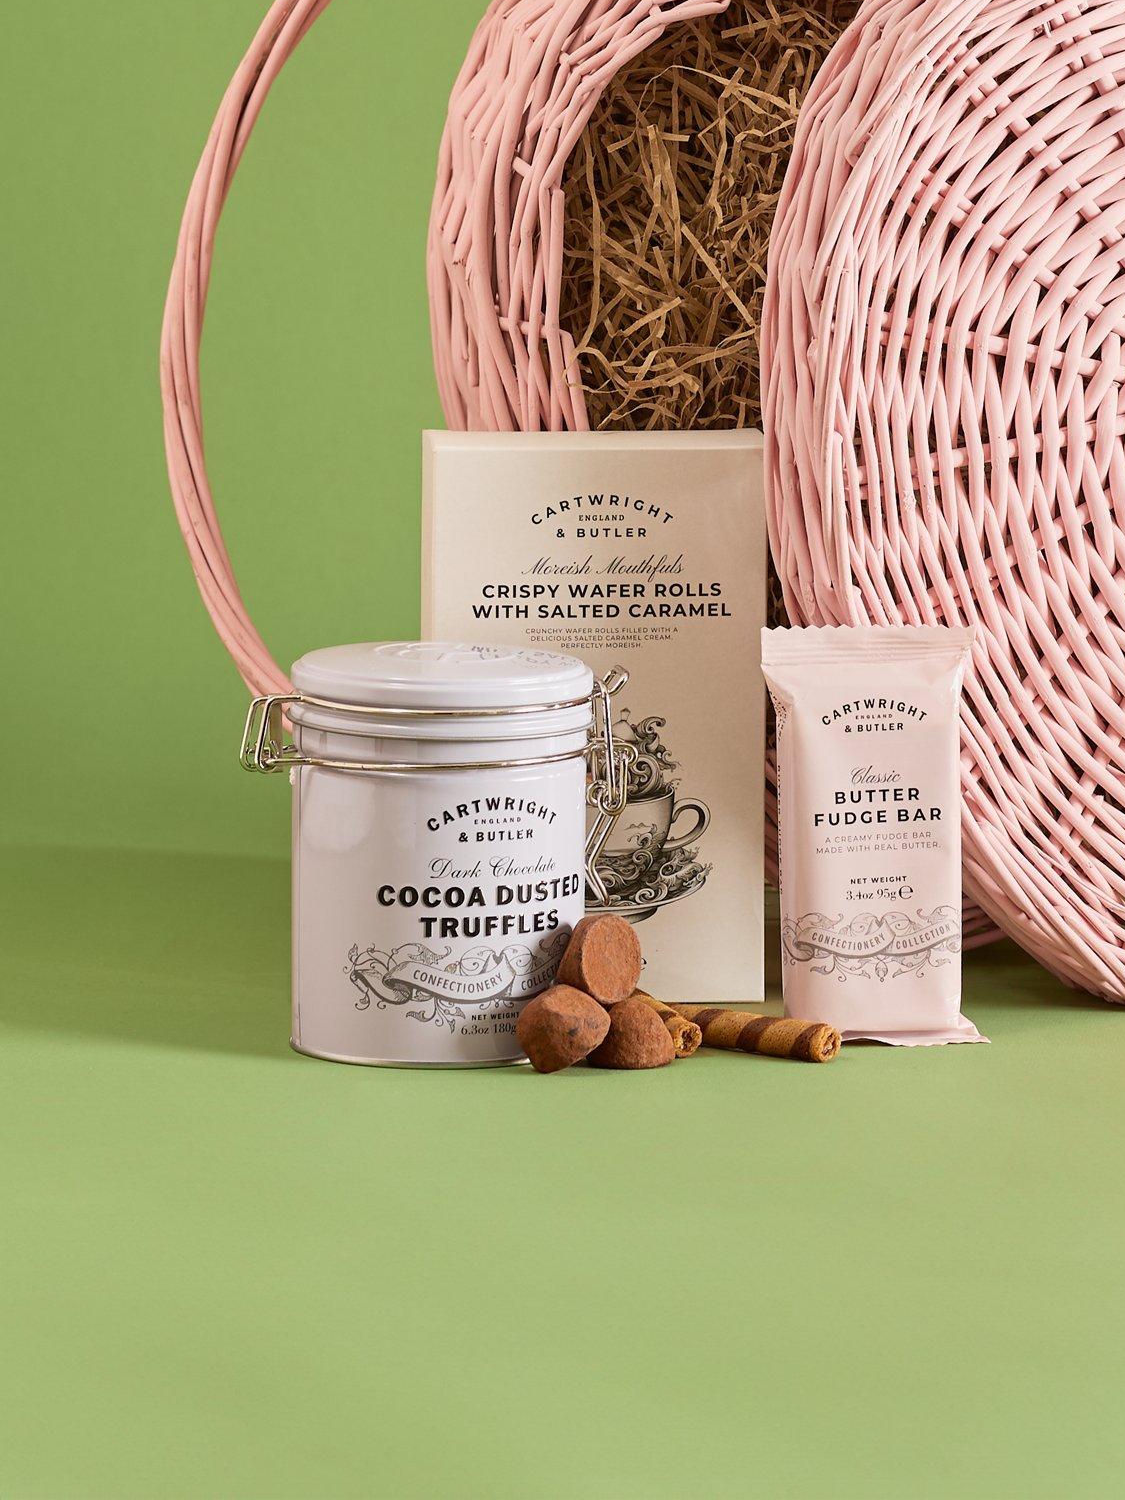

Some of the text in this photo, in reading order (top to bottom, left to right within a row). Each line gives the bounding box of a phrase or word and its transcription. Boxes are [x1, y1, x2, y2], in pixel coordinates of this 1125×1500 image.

[531, 493, 674, 525] CARTWRIGHT
[579, 514, 625, 522] ENGLAND
[556, 527, 648, 538] & BUTLER
[521, 554, 684, 582] Moreish Mouthfuls
[482, 582, 722, 599] CRISPY WAFER ROLLS
[472, 602, 732, 619] WITH SALTED CARAMEL
[821, 698, 928, 726] CARTWRIGHT
[844, 722, 904, 733] & BUTLER
[850, 765, 902, 785] Classic
[834, 787, 920, 805] BUTTER
[426, 796, 558, 832] CARTWRIGHT
[473, 816, 522, 825] ENGLAND
[814, 807, 942, 827] FUDGE BAR
[458, 829, 534, 843] & BUTLER
[834, 834, 873, 843] CREAMY
[876, 832, 908, 841] FUDGE
[912, 831, 932, 839] BAR
[816, 841, 942, 855] MADE WITH REAL BUTTER.
[428, 855, 556, 880] Dark Chocolate
[850, 875, 908, 885] NET WEIGHT
[377, 873, 579, 908] COCOA DUSTED
[845, 888, 874, 901] 3.4oz
[876, 888, 897, 902] 95g
[419, 908, 559, 938] TRUFFLES
[811, 924, 952, 952] CONFECTIONERY COLLECTION
[413, 969, 503, 994] CONFECTIONERY
[490, 1012, 520, 1020] WEIGHT
[460, 1023, 517, 1036] 6.3oz 180g
